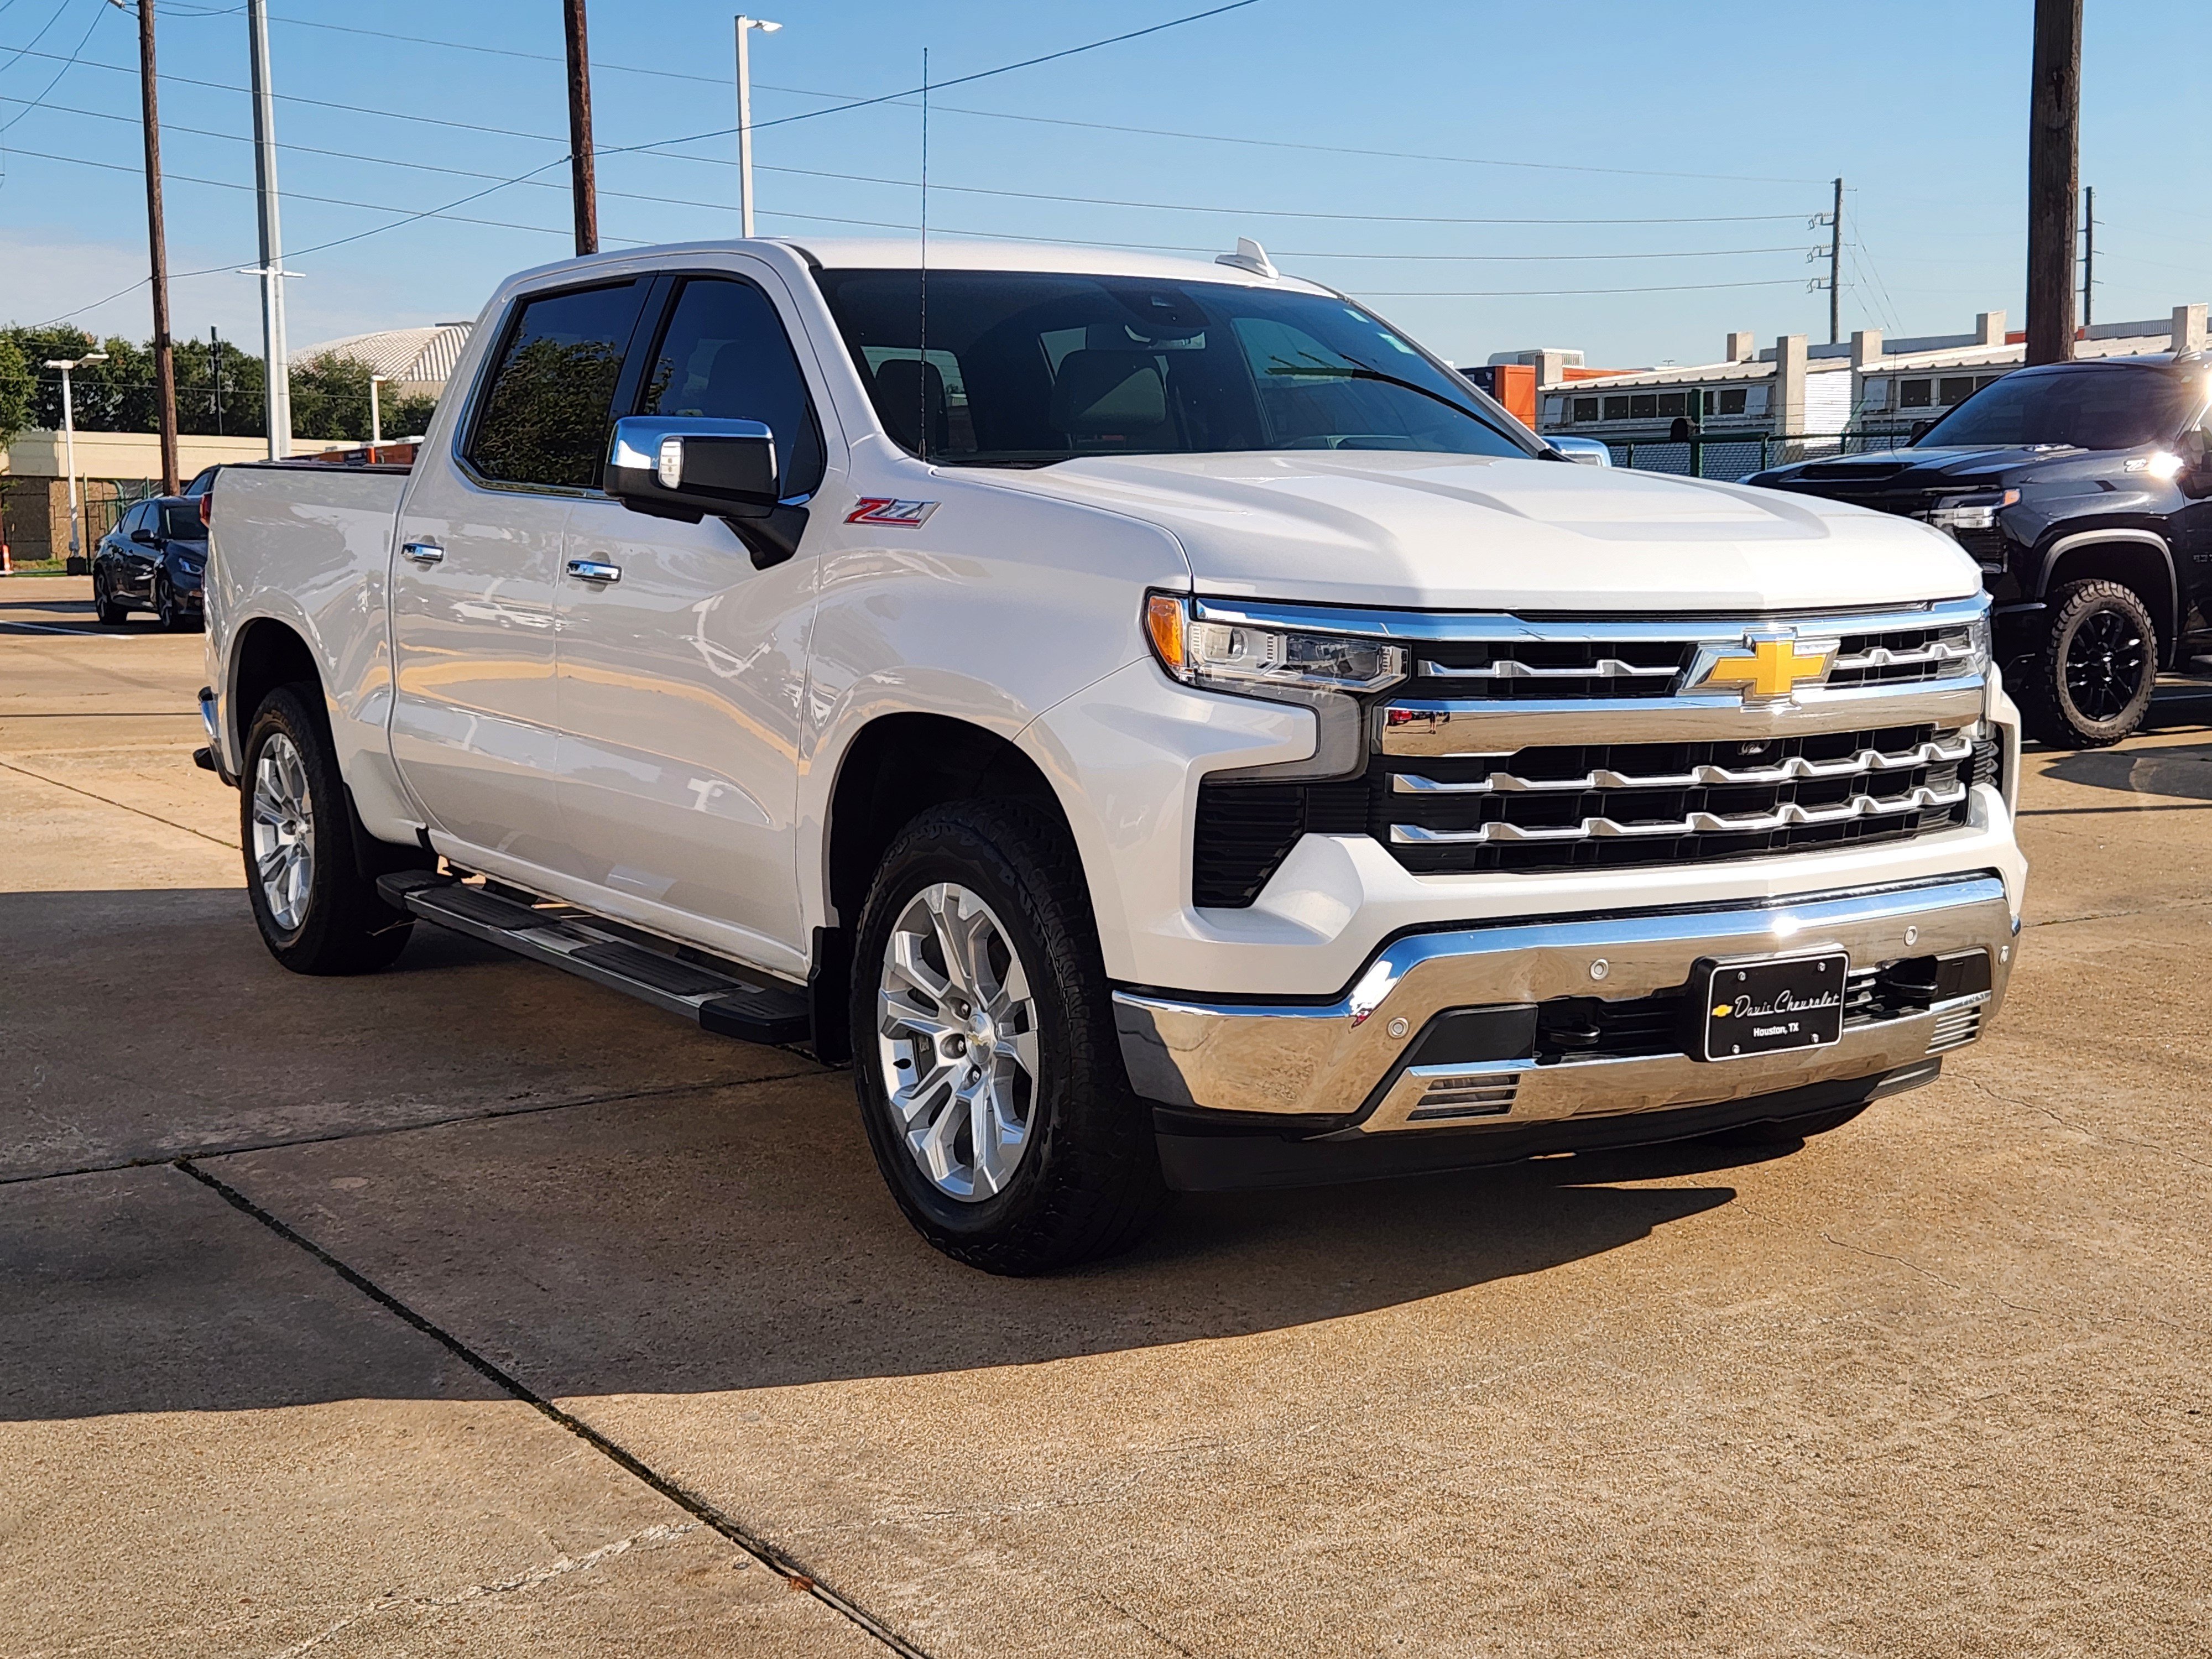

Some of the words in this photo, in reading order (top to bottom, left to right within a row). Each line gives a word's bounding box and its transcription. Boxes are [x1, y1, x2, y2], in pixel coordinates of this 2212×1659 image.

[843, 497, 941, 529] Z71
[1734, 995, 1773, 1018] Davis
[1774, 990, 1840, 1013] Chevrolet
[1754, 1025, 1787, 1037] Houston,
[1788, 1022, 1799, 1032] TX
